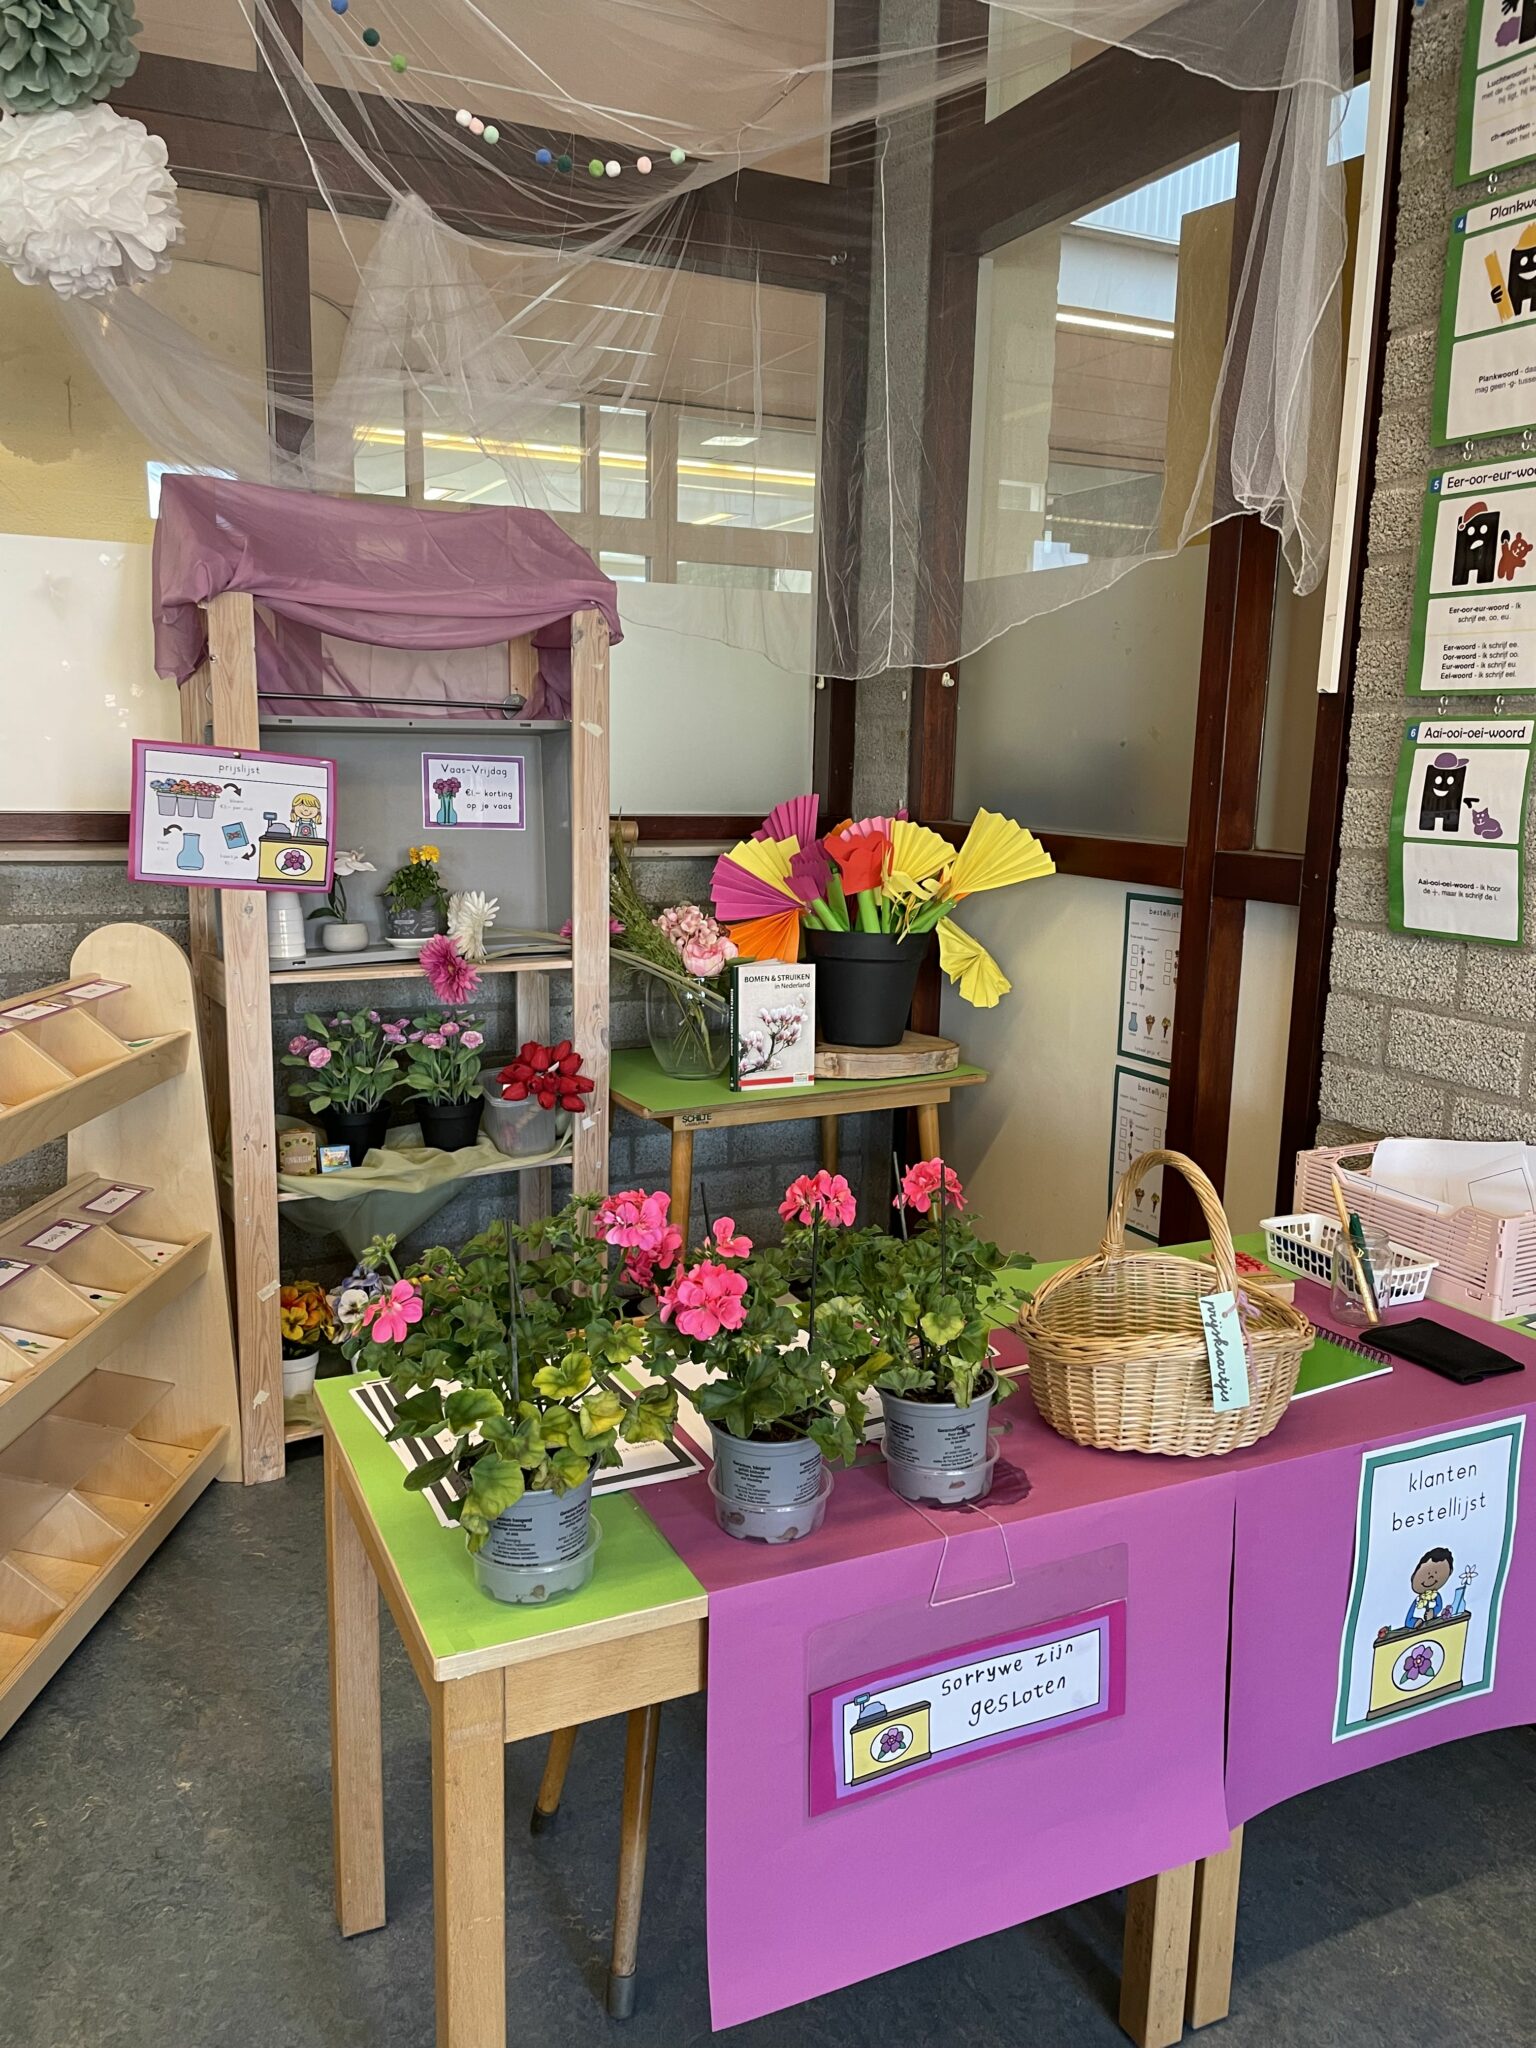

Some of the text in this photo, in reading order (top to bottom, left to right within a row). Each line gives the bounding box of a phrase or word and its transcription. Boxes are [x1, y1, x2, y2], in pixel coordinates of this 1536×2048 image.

[1457, 218, 1464, 229] 4
[1478, 368, 1519, 383] Plankwoord
[1475, 386, 1488, 394] mag
[1490, 382, 1506, 392] geen
[1447, 467, 1536, 489] Eer-oor-eur-wo
[1433, 480, 1439, 489] 5
[1449, 603, 1509, 614] Eer-oor-eur-woord
[1458, 615, 1477, 623] schrijf
[1443, 643, 1476, 651] Eer-woord
[1489, 641, 1507, 650] schrijf
[1489, 651, 1508, 659] schrijf
[1441, 662, 1475, 670] Eur-woord
[1488, 661, 1506, 669] schrijf
[1485, 671, 1504, 679] schrijf
[1410, 728, 1416, 737] 6
[1424, 727, 1526, 739] Aai-ooi-oei-woord
[219, 764, 260, 776] prijslijst
[441, 763, 507, 778] Vaas-Vrijdag
[484, 789, 512, 800] korting
[466, 803, 476, 811] op
[481, 803, 489, 811] je
[1418, 878, 1474, 889] Aai-ooi-oei-woord
[1465, 892, 1483, 901] schrijf
[744, 975, 770, 983] BOMEN
[777, 974, 810, 982] STRUIKEN
[1200, 1300, 1233, 1402] prijskaartjes
[1408, 1464, 1477, 1492] klanten
[1392, 1491, 1486, 1532] bestellijst
[1035, 1643, 1073, 1667] zijn
